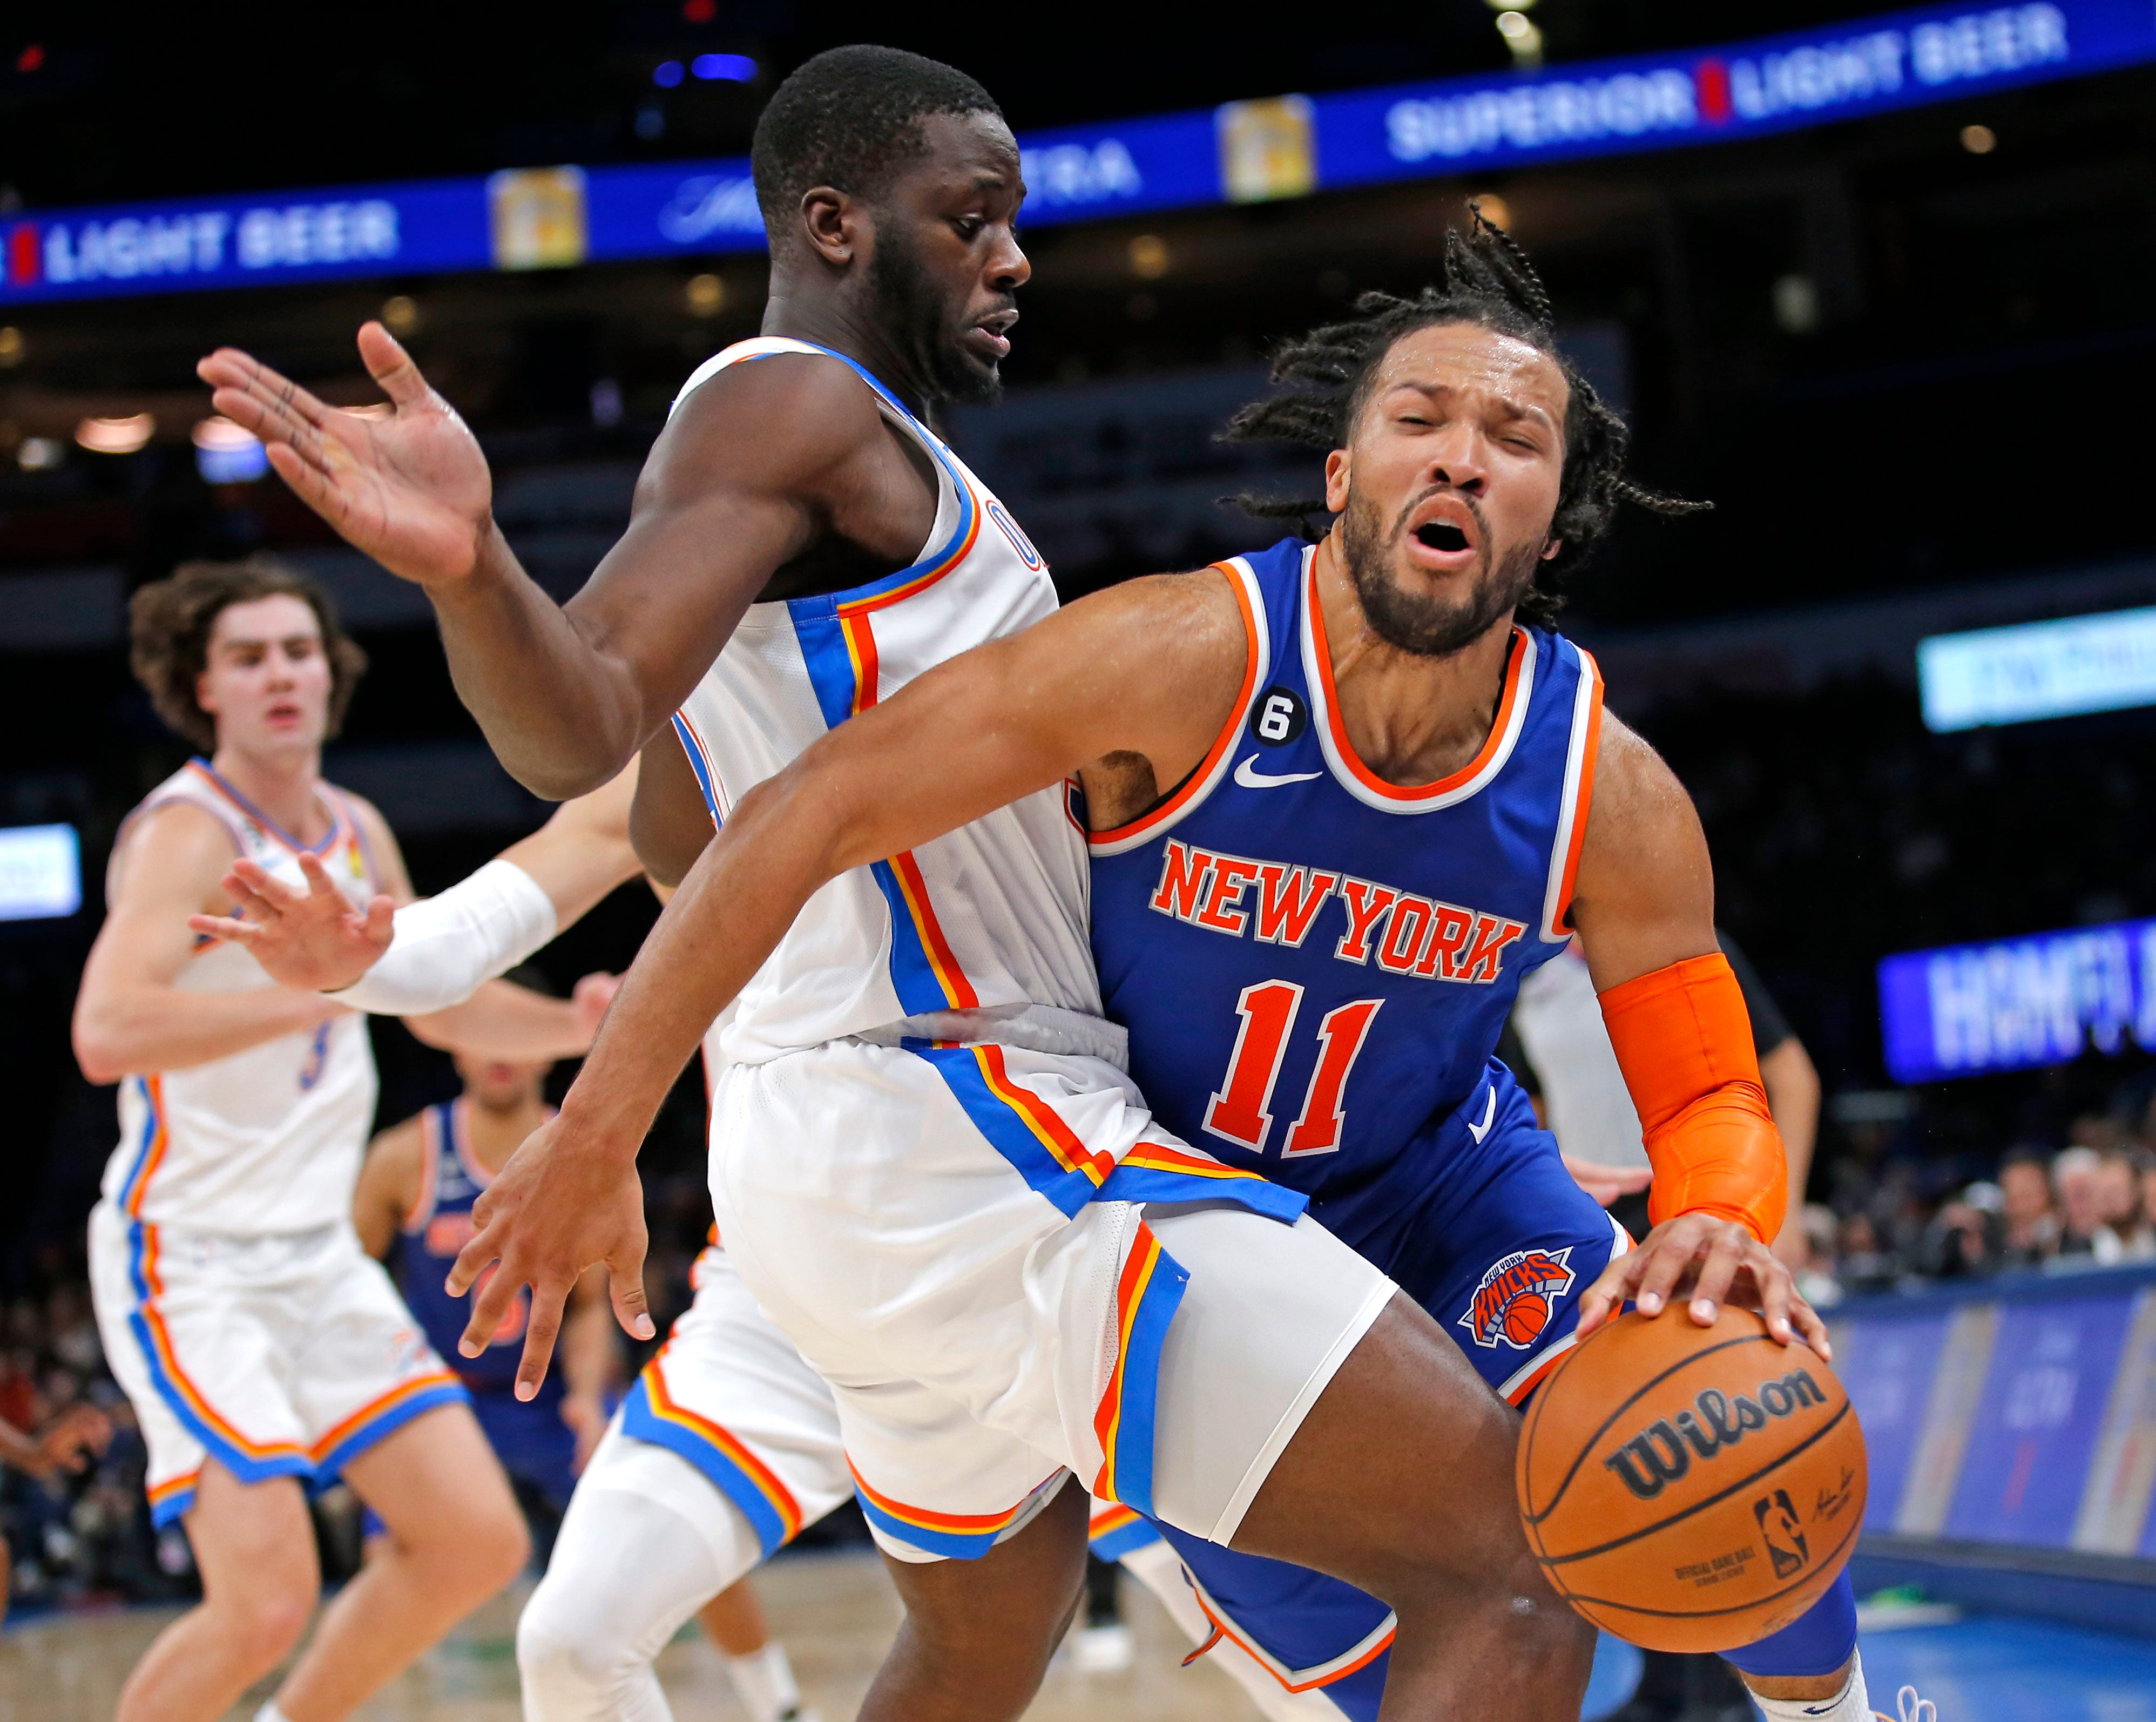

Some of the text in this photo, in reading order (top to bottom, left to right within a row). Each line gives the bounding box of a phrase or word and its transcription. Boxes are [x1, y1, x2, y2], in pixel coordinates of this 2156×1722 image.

[1385, 2, 2068, 162] SUPERIOR LIGHT BEER
[45, 200, 401, 283] LIGHT BEER
[1259, 695, 1293, 740] 6
[1148, 836, 1529, 984] NEW YORK
[1201, 978, 1385, 1159] 11
[1474, 1253, 1570, 1341] KNICKS
[1485, 1254, 1524, 1287] NEW YORK
[1603, 1368, 1827, 1500] Wilson
